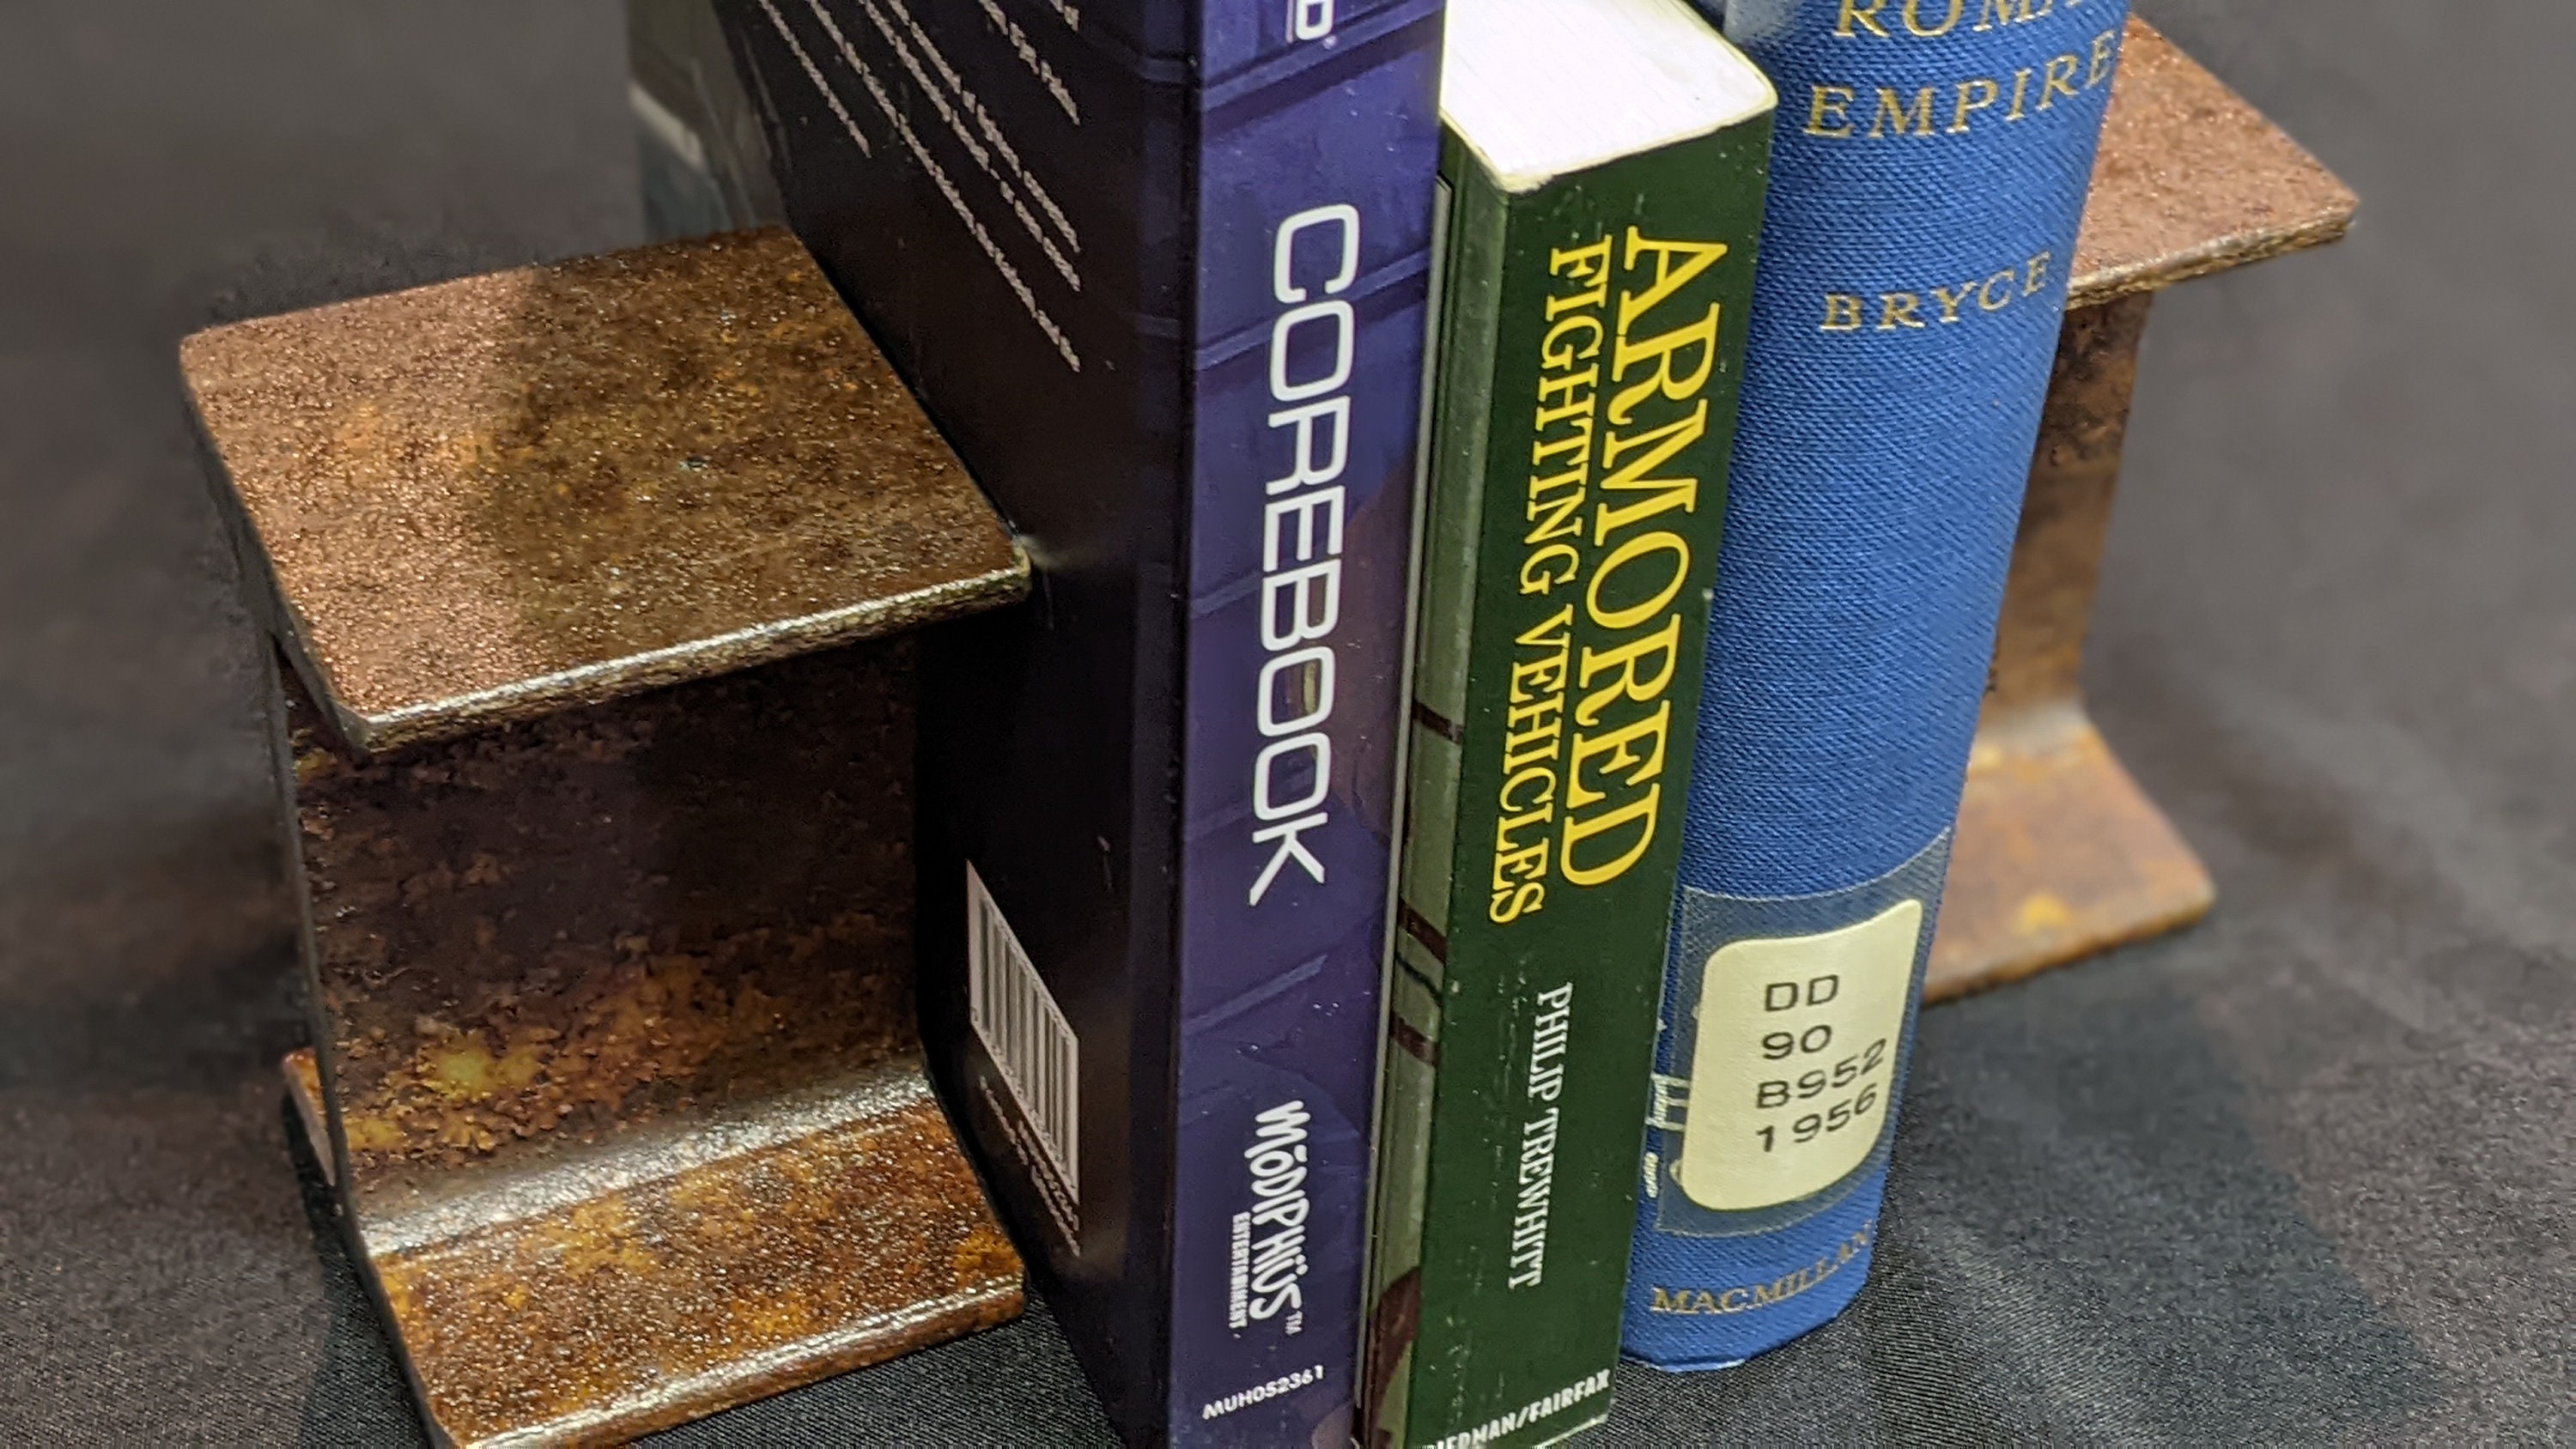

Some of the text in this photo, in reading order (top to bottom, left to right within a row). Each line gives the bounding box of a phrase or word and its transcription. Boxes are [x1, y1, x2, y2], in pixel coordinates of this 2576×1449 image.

[1832, 0, 2081, 37] ROM
[1803, 30, 2116, 138] EMPIRE
[1820, 251, 2050, 332] BRYCE
[1249, 203, 1360, 906] COREBOOK
[1489, 233, 1613, 924] FIGHTING VEHICLES
[1559, 225, 1728, 886] ARMORED
[1765, 974, 1839, 1012] DD
[1756, 1038, 1886, 1109] B952
[1762, 1024, 1832, 1060] 90
[1508, 981, 1573, 1288] PHILIP TREWHITT
[1756, 1082, 1877, 1152] 1956
[1648, 1218, 1873, 1314] MACMILLAN
